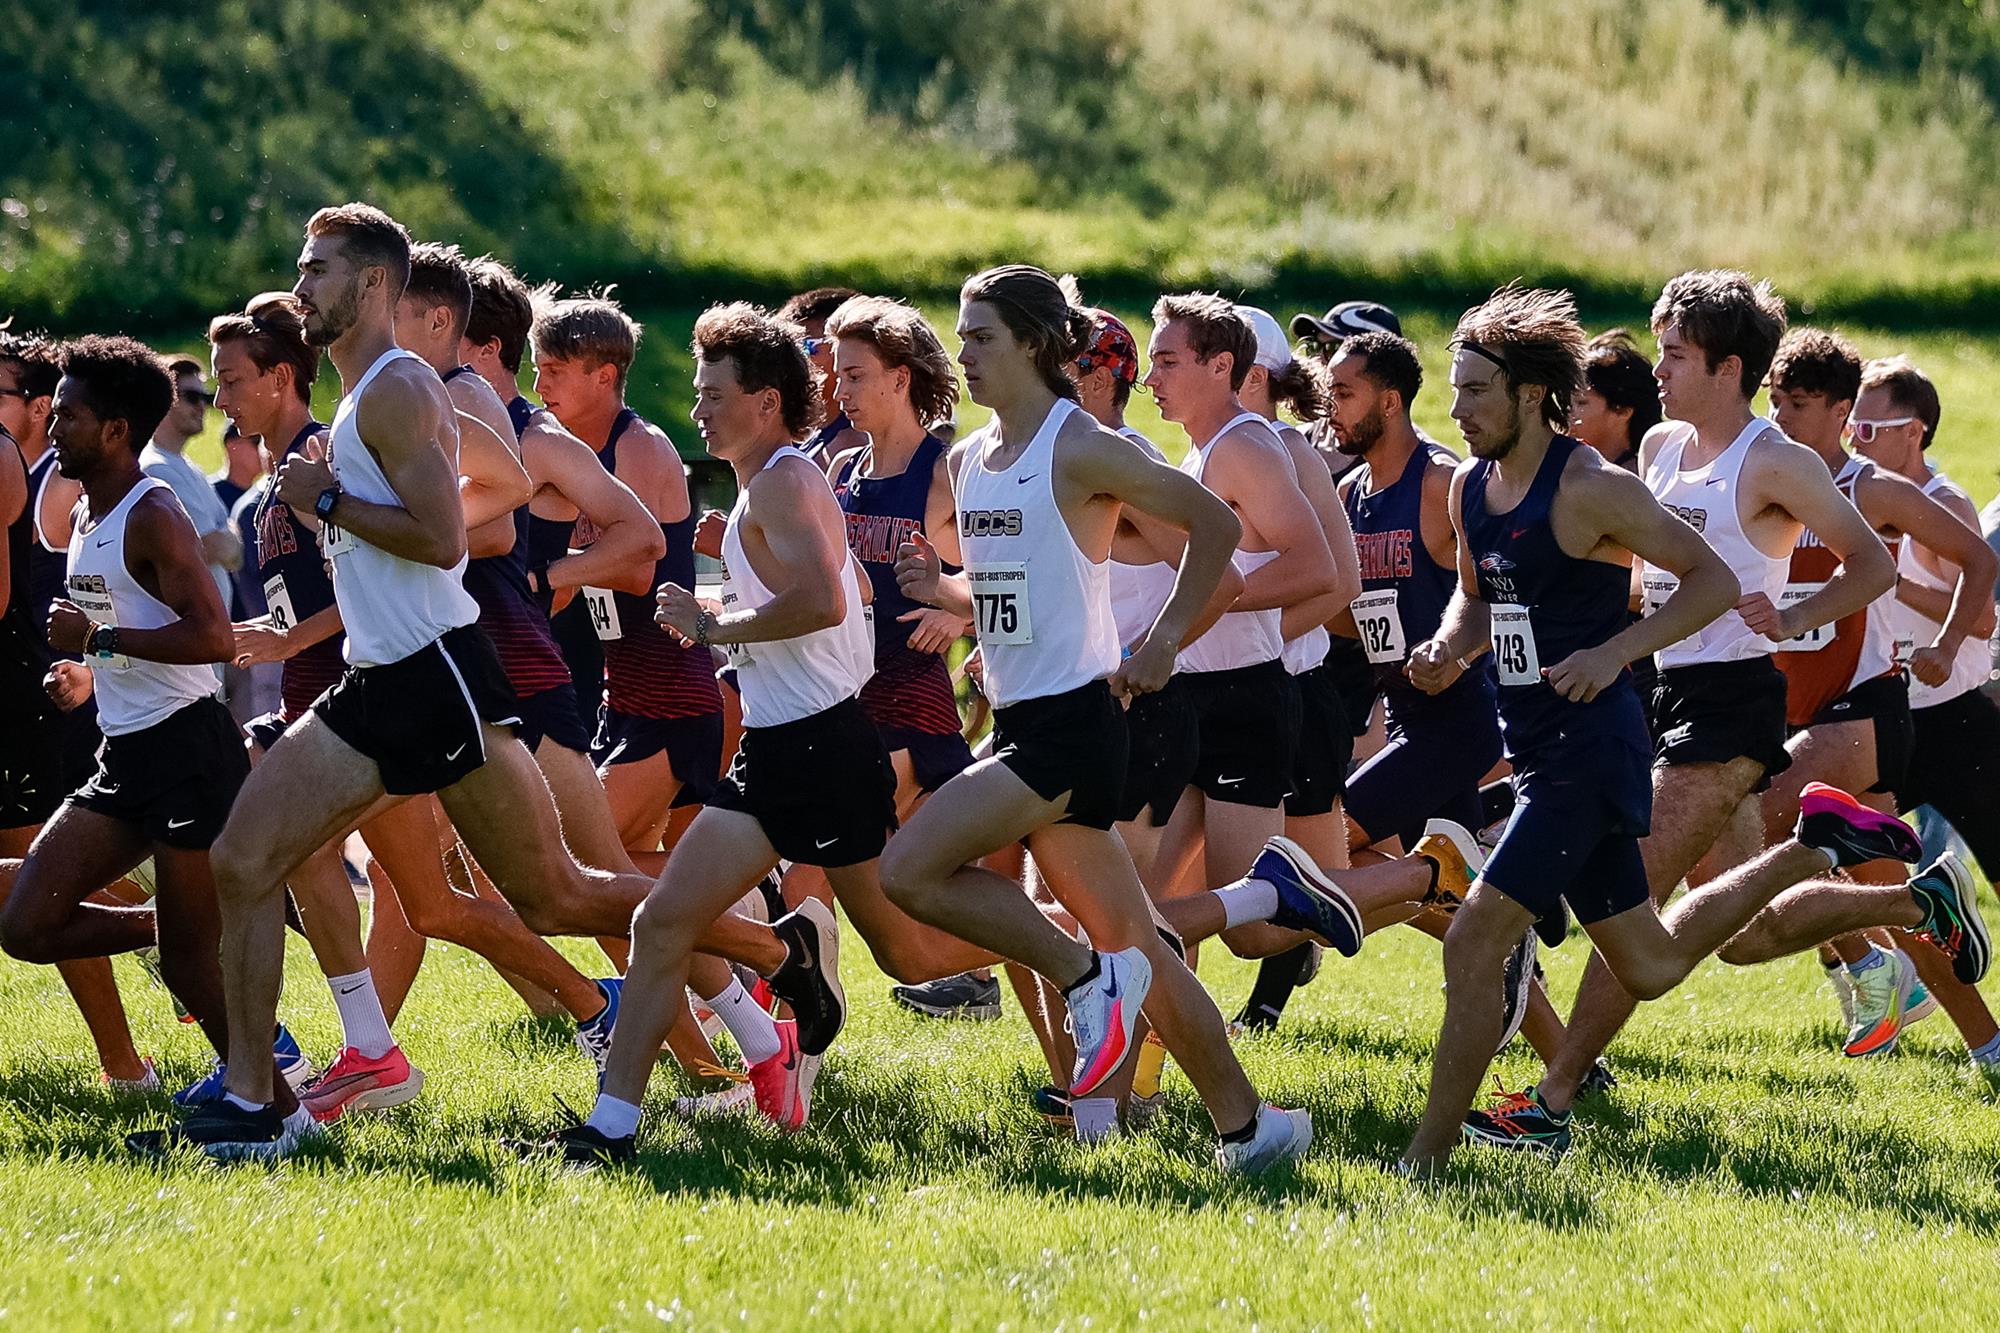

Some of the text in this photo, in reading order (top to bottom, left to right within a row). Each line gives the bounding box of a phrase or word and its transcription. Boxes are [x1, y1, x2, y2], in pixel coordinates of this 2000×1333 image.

[961, 509, 1023, 538] UCCS
[973, 593, 1018, 634] 775
[1359, 616, 1395, 654] 732
[1493, 633, 1528, 675] 743
